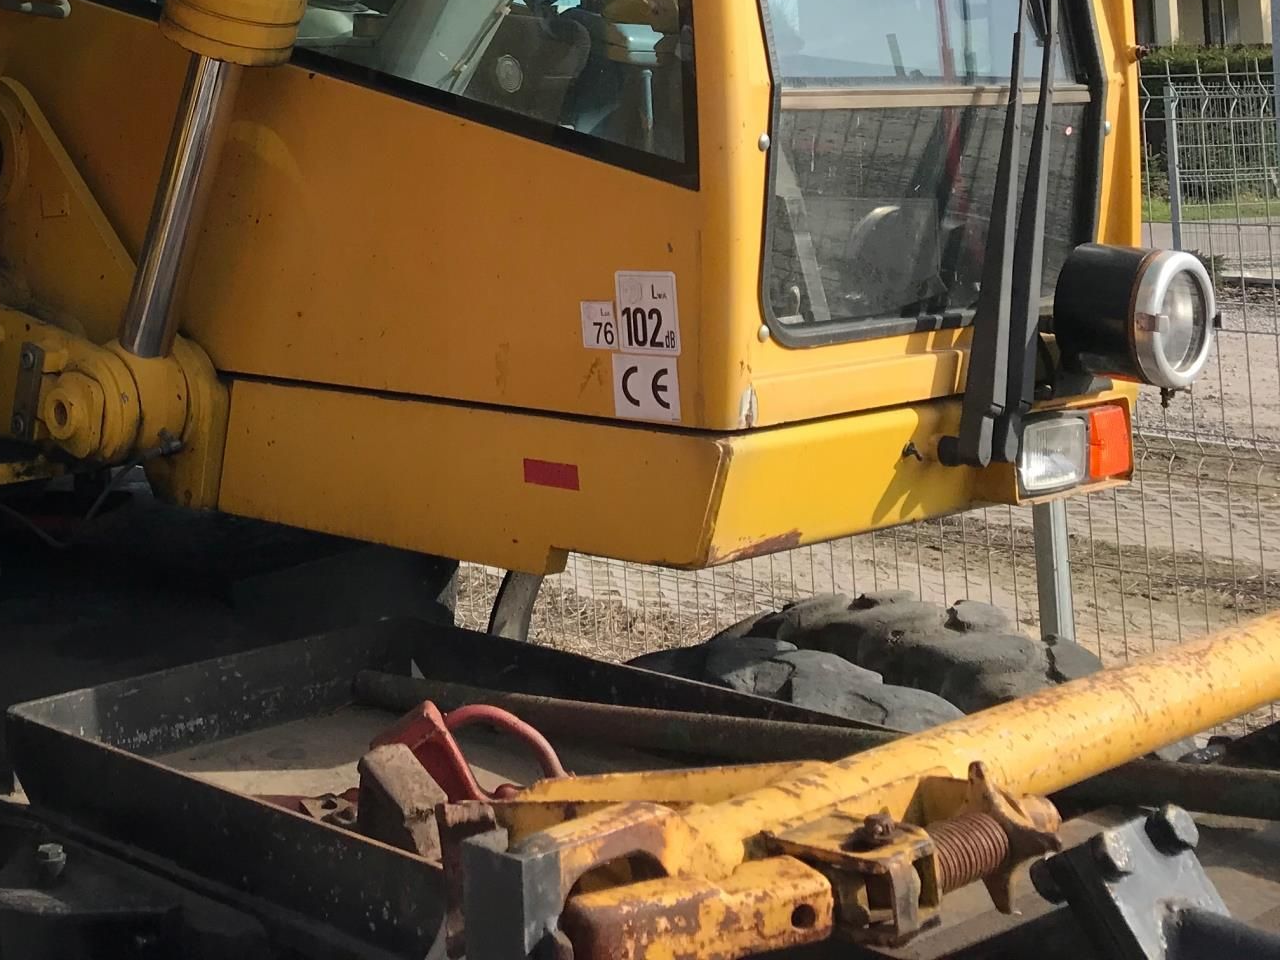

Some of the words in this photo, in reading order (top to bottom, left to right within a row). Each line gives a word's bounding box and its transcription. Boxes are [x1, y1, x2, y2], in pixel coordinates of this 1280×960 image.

[592, 322, 614, 344] 76
[621, 307, 664, 348] 102
[665, 330, 675, 348] dB
[622, 366, 670, 409] CE
